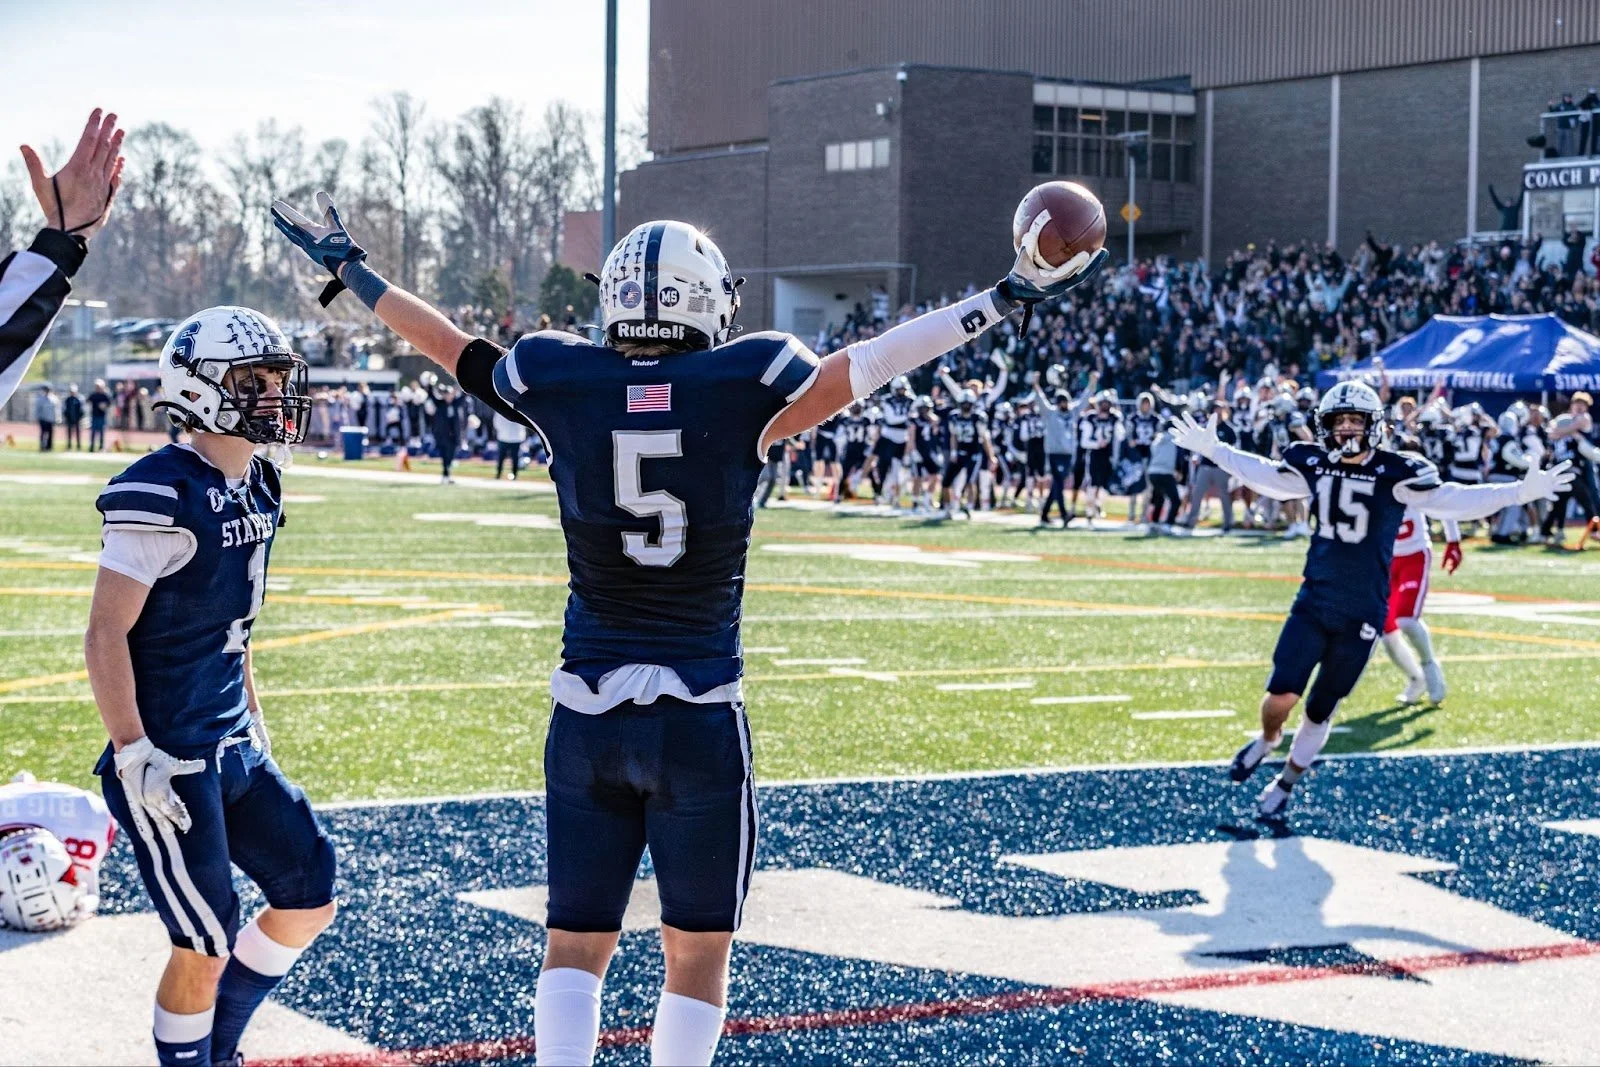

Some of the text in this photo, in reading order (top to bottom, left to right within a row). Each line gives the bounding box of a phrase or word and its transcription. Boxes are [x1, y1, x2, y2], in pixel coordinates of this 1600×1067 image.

[1524, 169, 1582, 189] COACH
[660, 289, 679, 303] MS
[617, 322, 685, 341] Riddell
[631, 359, 660, 367] Riddell
[1452, 372, 1516, 390] FOOTBALL
[611, 429, 689, 568] 5
[1316, 475, 1376, 544] 15
